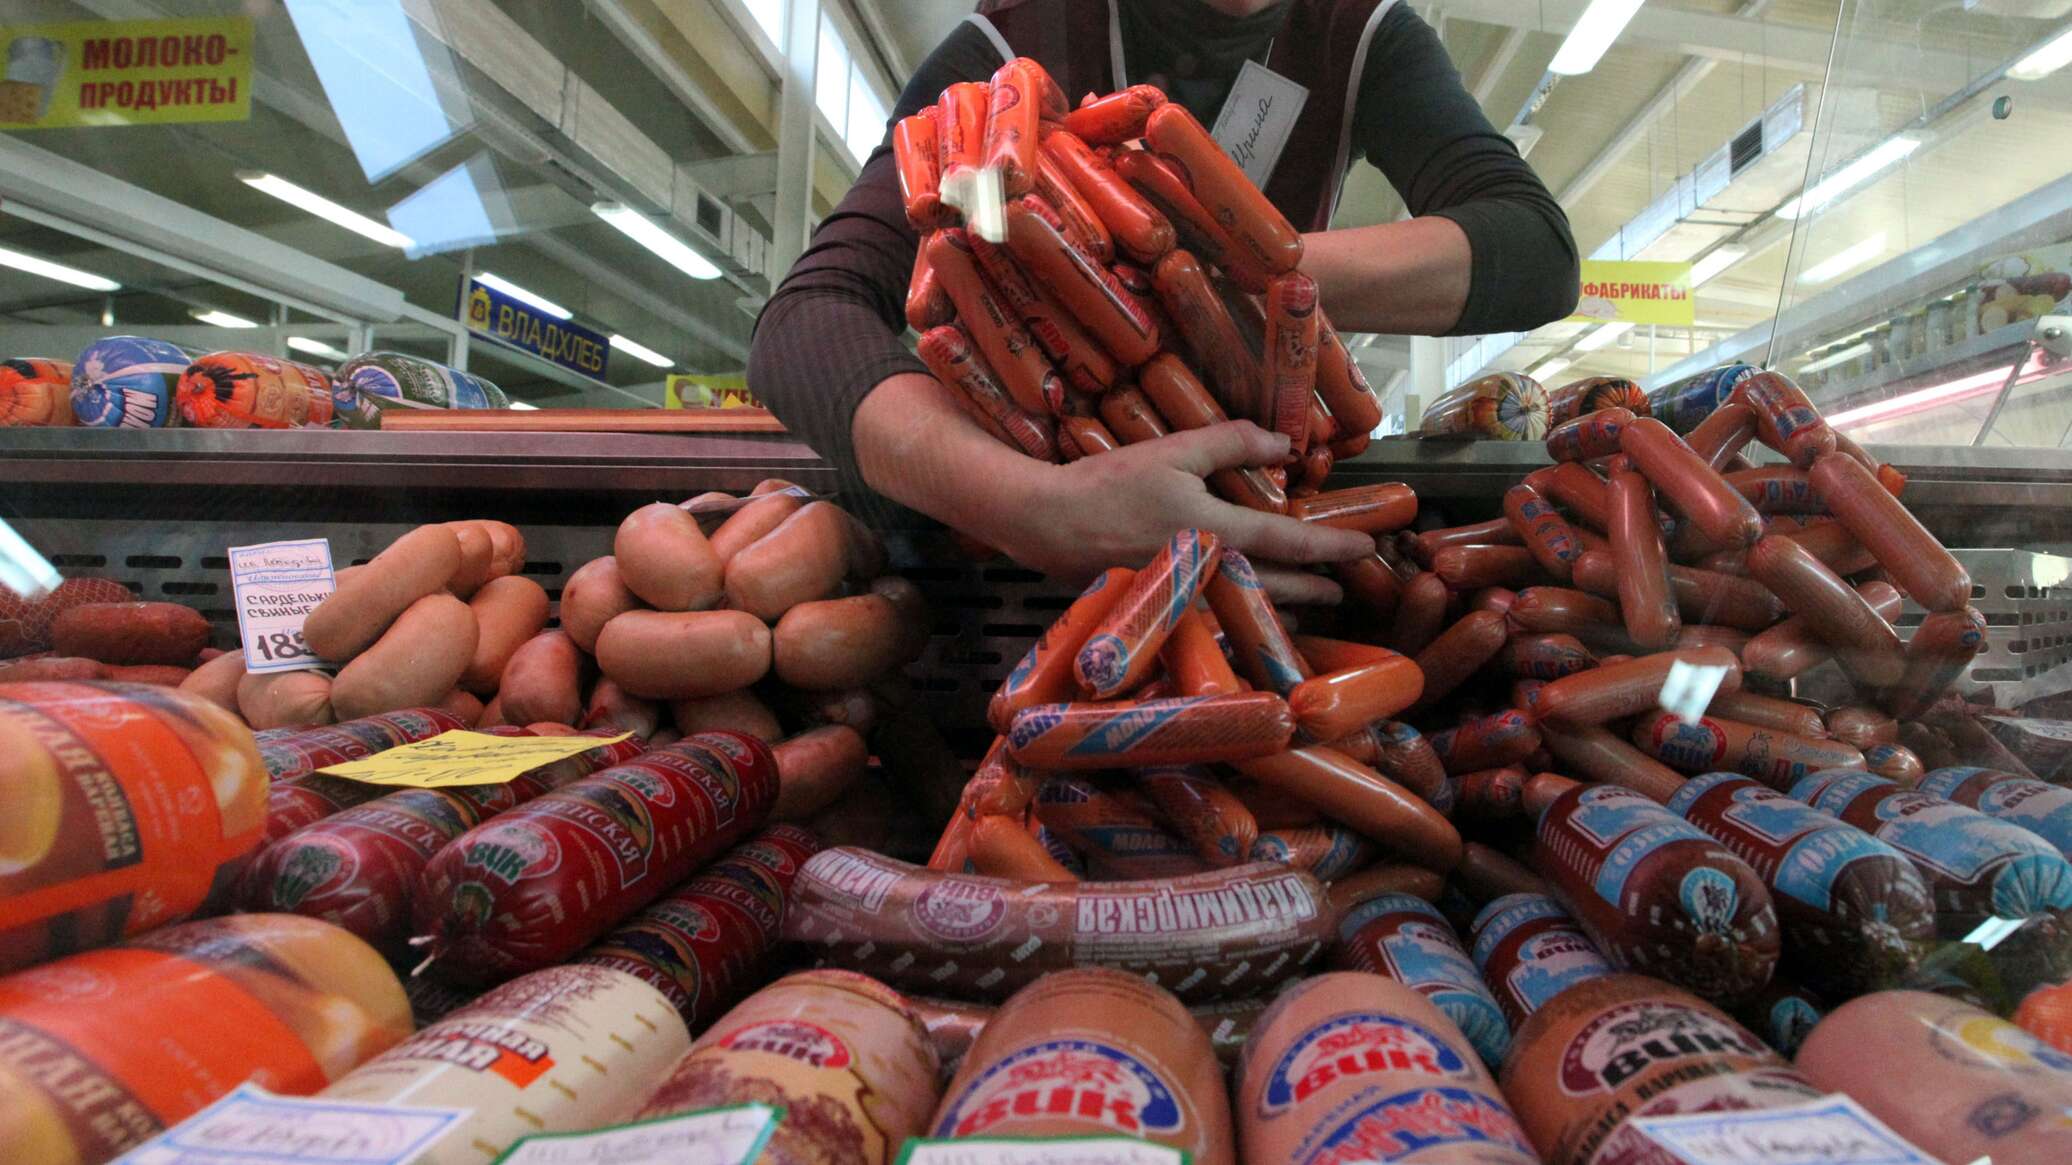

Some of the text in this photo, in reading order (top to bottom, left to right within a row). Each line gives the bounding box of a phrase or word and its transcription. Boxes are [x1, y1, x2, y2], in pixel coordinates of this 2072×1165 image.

[82, 34, 239, 71] МОЛОКО-
[80, 77, 238, 110] ПРОДУКТЫ
[1579, 281, 1687, 301] ФАБРИКАТЫ
[500, 303, 604, 373] ВЛАДХЛЕБ
[246, 605, 312, 619] СВИНЫЕ
